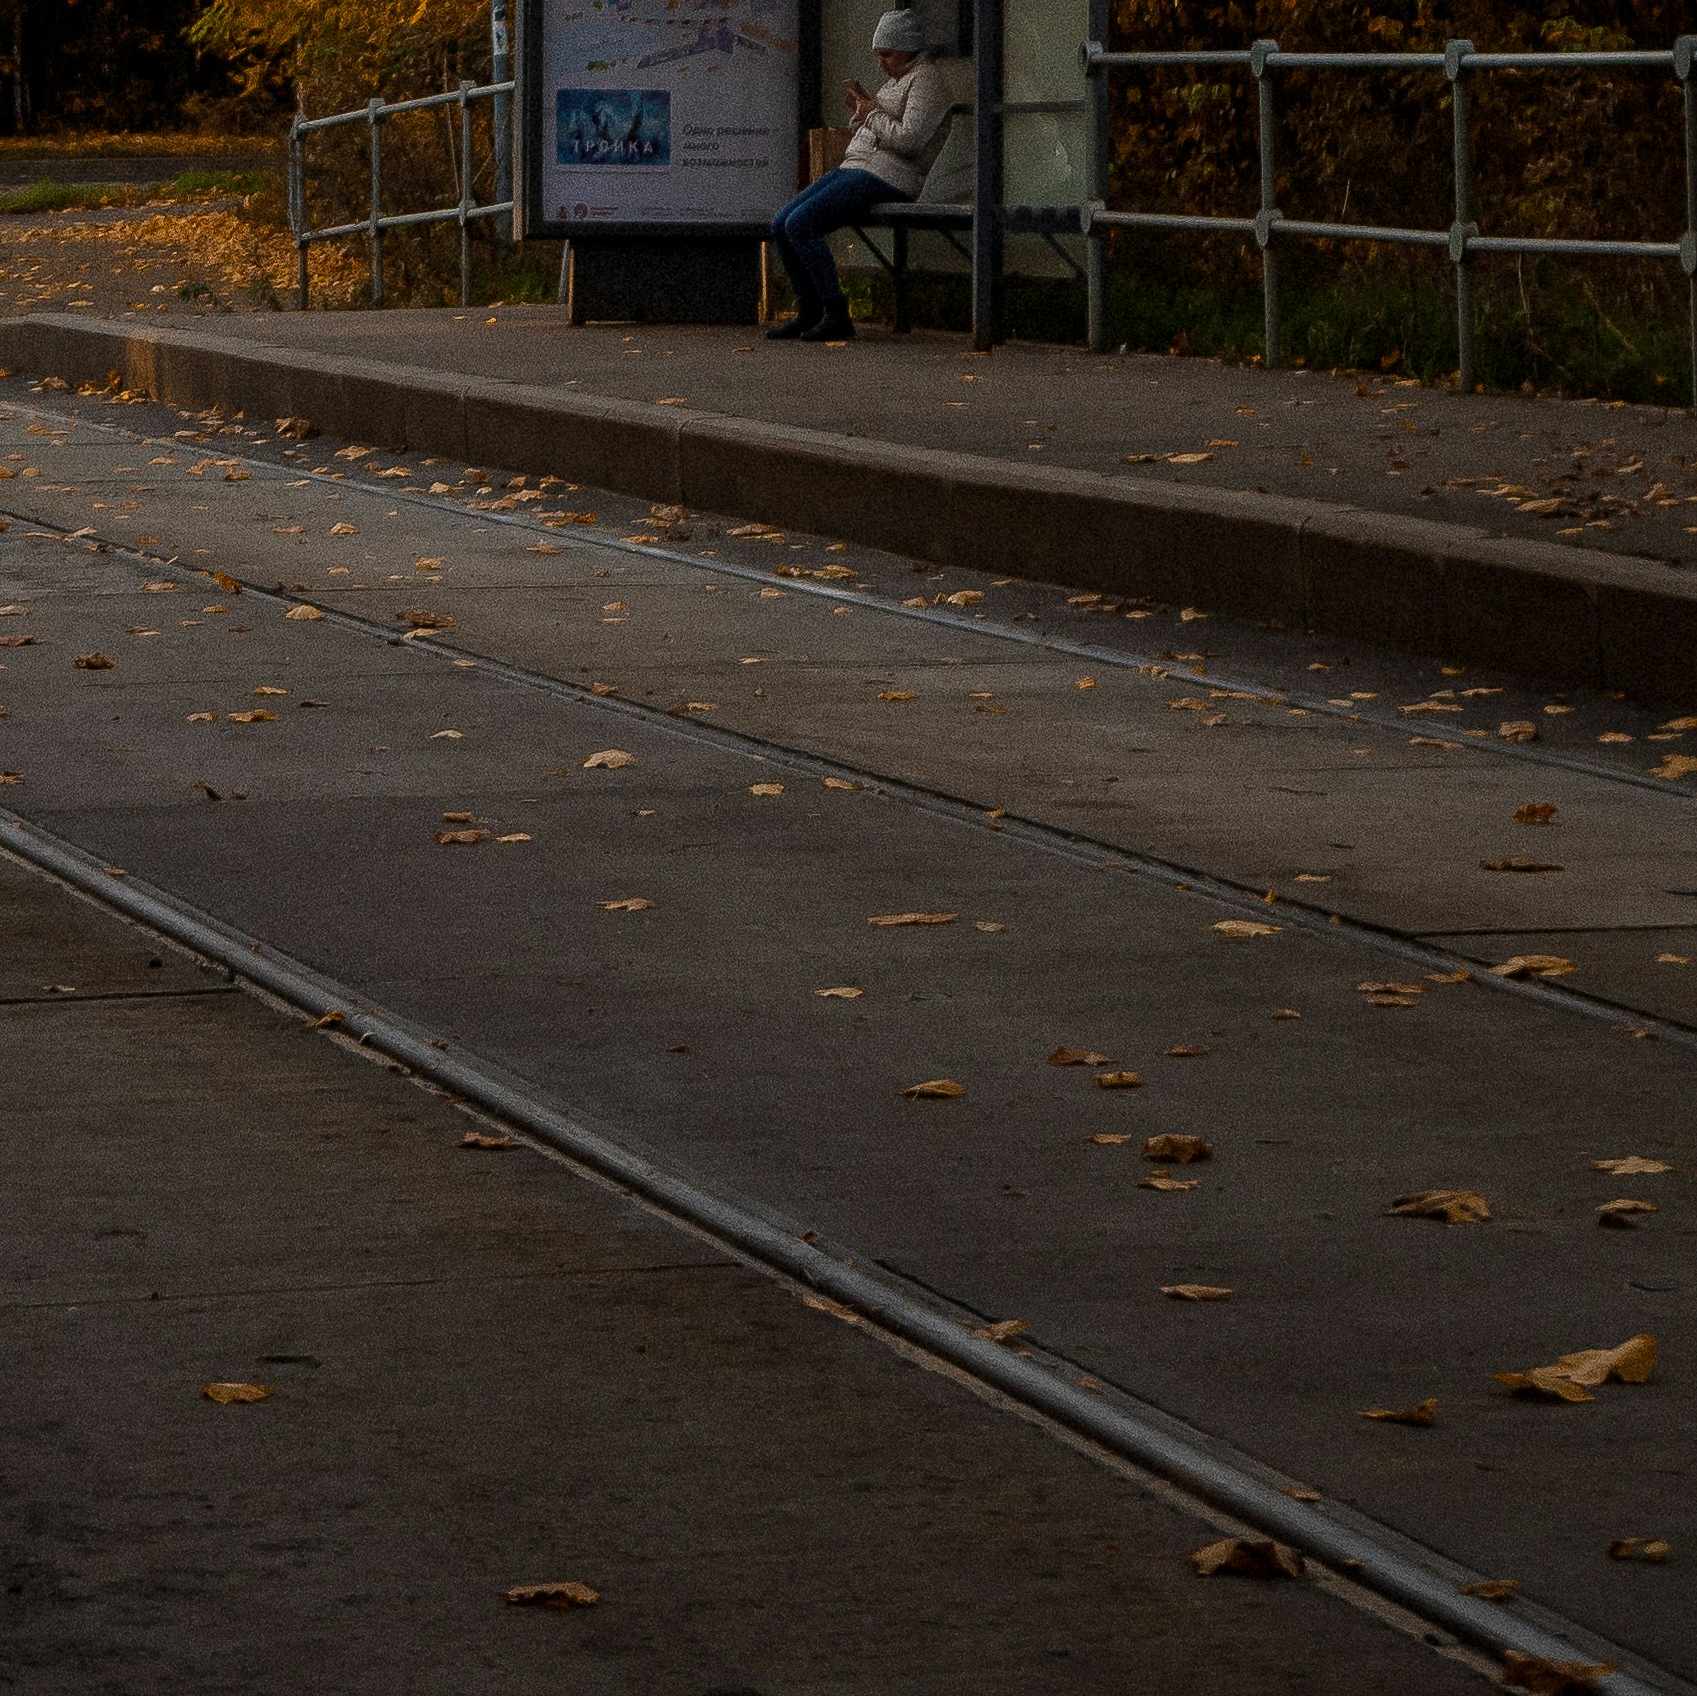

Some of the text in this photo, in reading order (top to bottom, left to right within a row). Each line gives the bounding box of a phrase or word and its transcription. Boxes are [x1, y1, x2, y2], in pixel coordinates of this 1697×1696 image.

[683, 123, 714, 136] Одно
[716, 126, 770, 137] решение
[683, 141, 720, 152] много
[682, 156, 770, 168] возможностей
